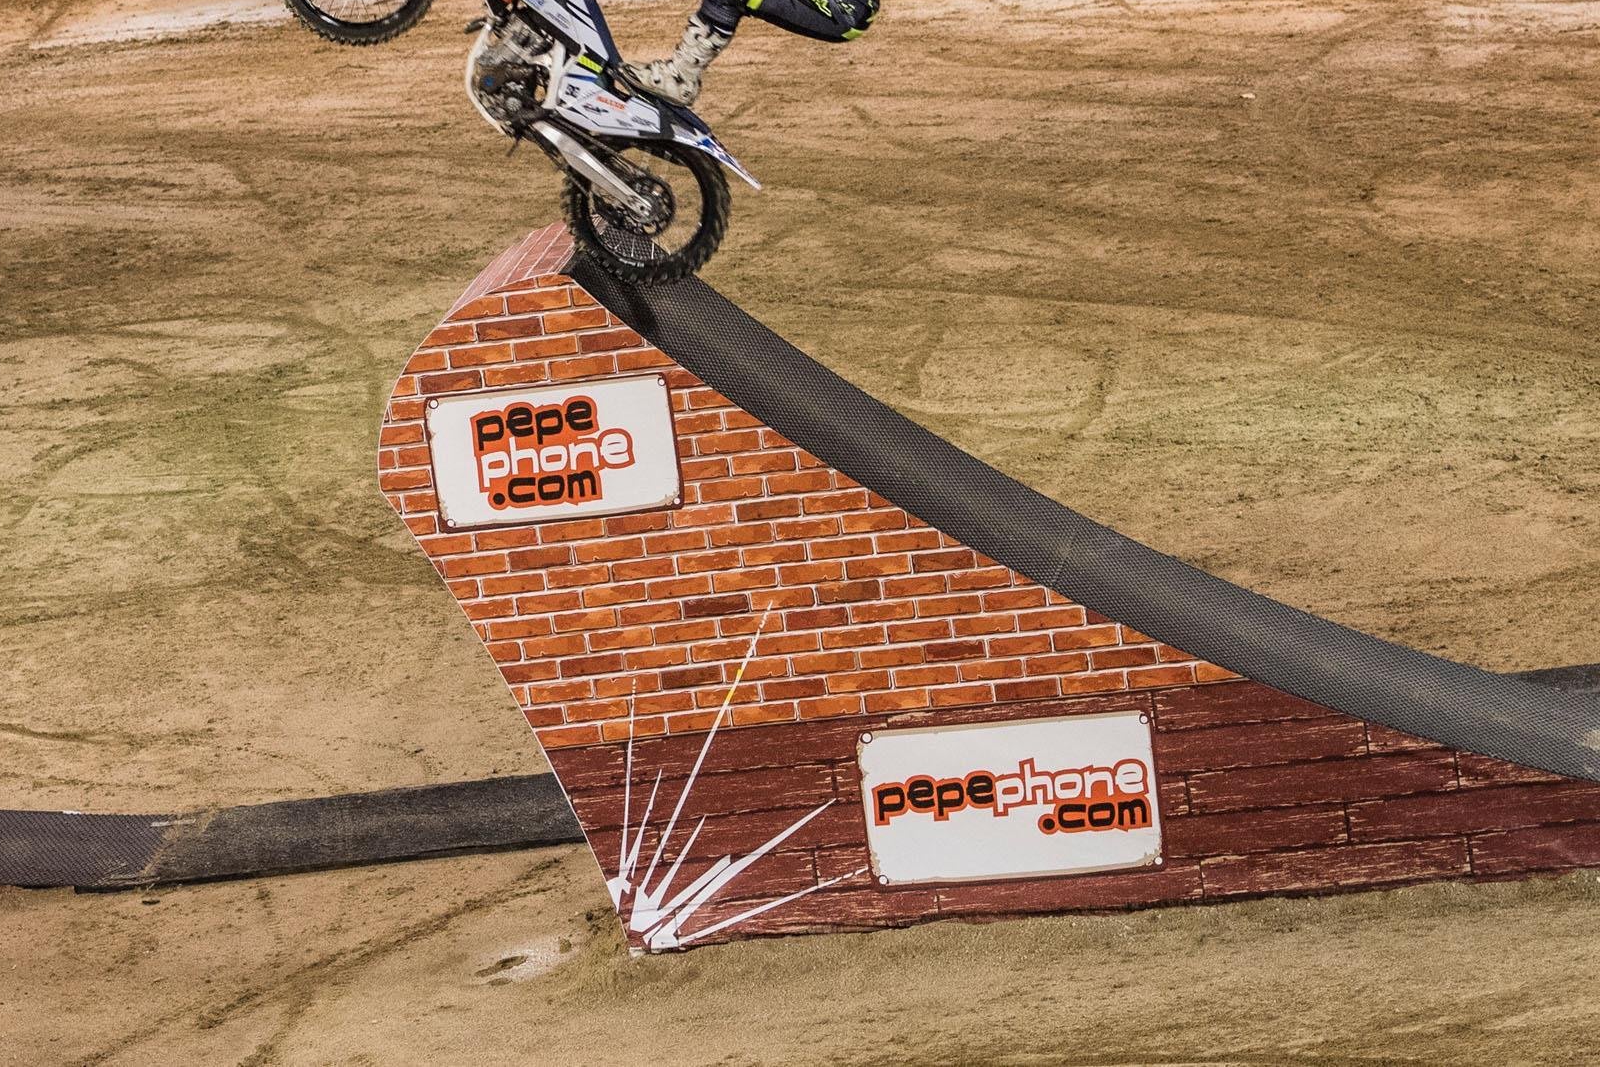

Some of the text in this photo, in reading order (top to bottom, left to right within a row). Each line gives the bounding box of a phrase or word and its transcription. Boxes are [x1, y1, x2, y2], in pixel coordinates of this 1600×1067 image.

[476, 401, 593, 451] pepe
[481, 433, 629, 487] phone
[493, 470, 597, 505] .com
[877, 763, 1145, 821] pepephone
[1043, 798, 1147, 831] .com
